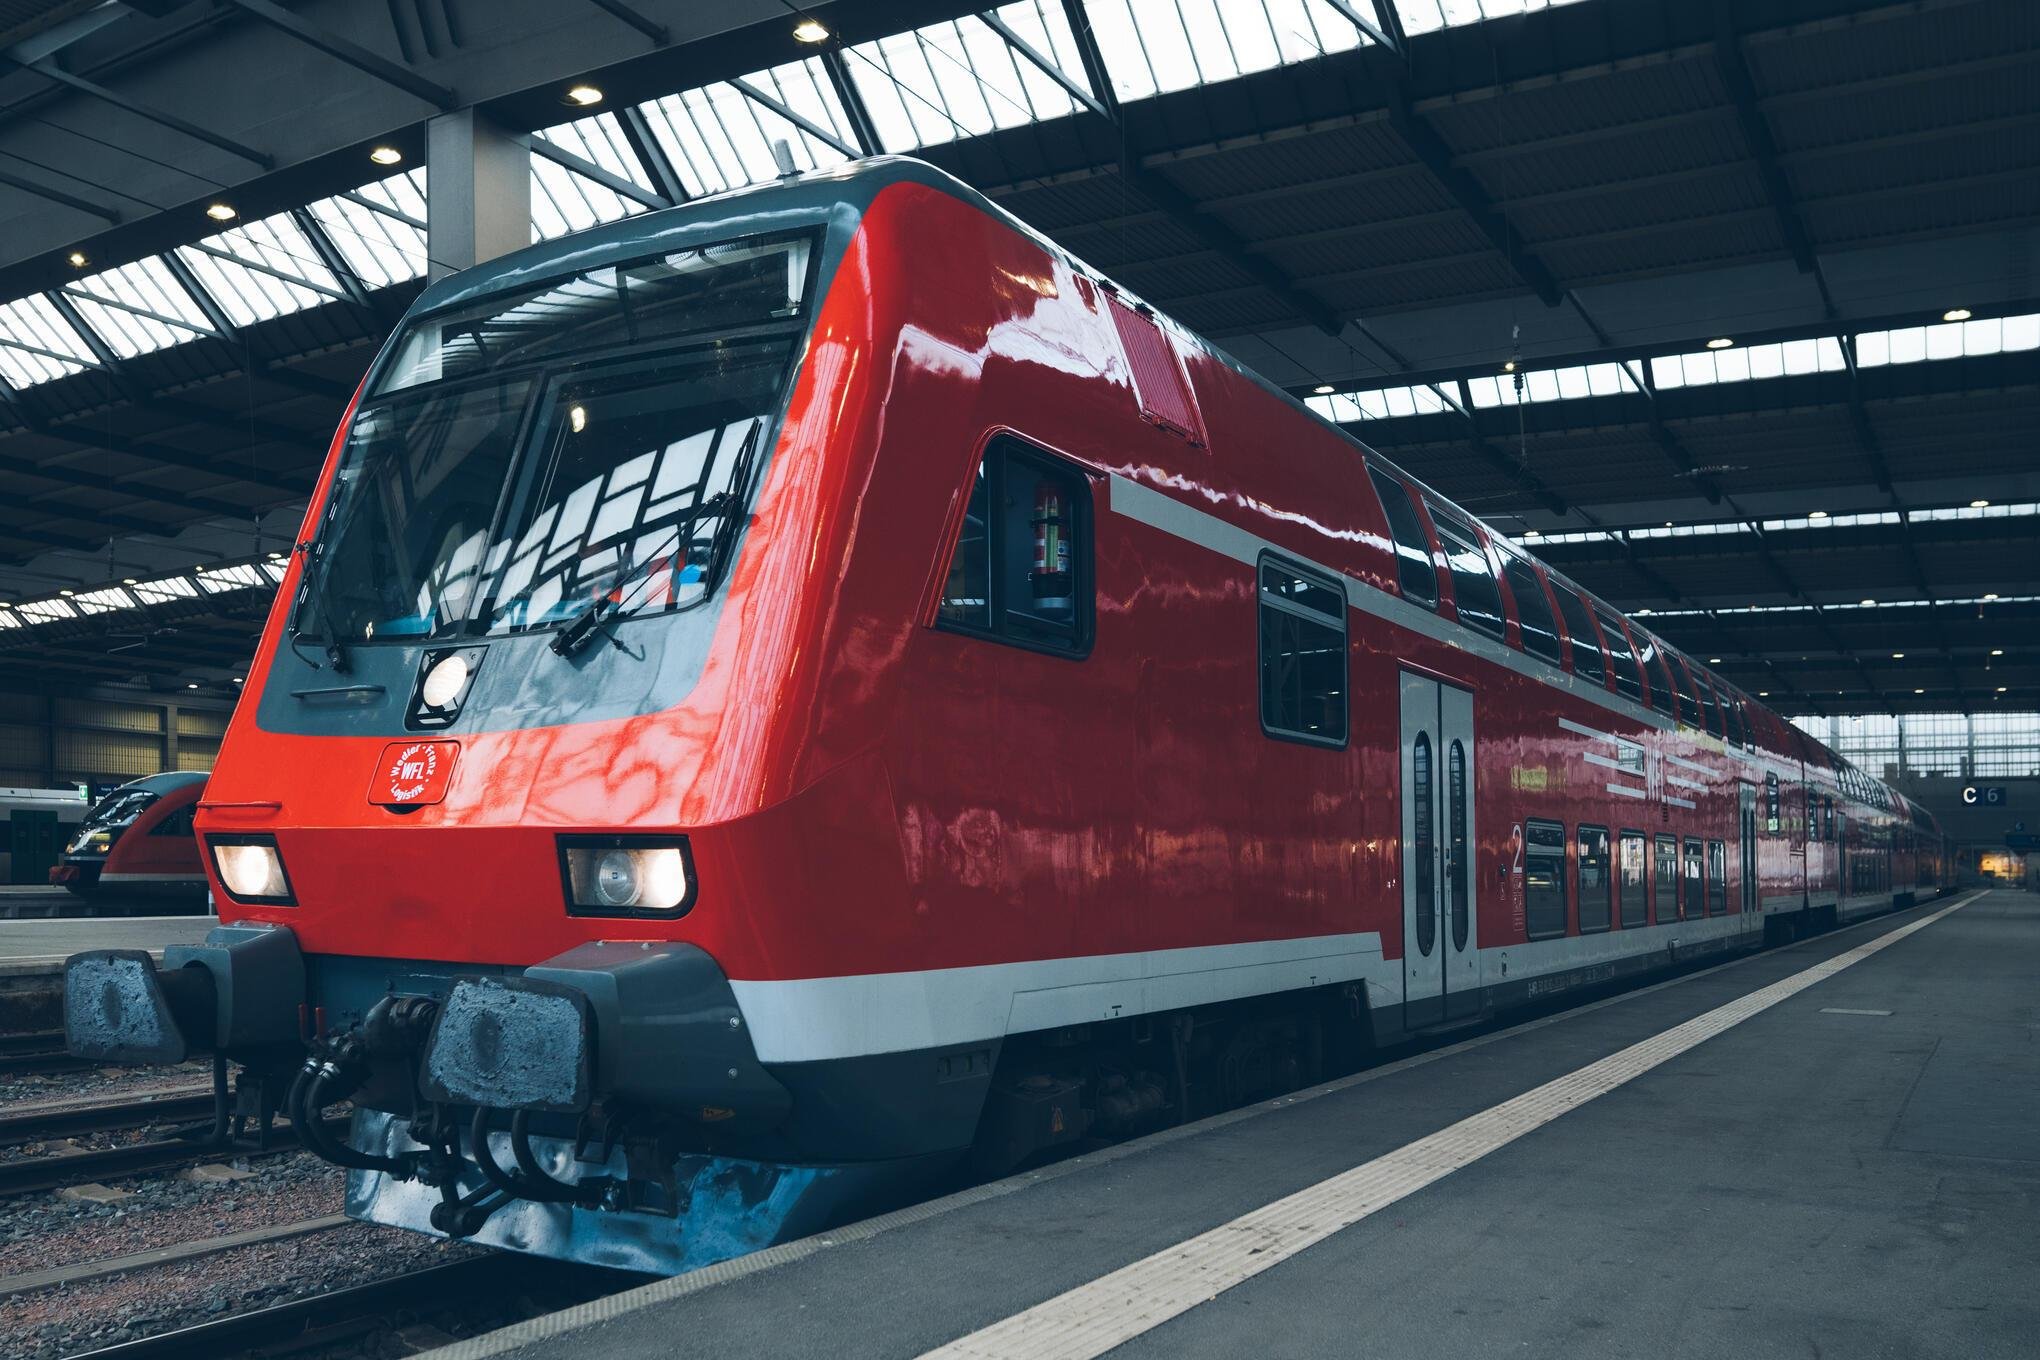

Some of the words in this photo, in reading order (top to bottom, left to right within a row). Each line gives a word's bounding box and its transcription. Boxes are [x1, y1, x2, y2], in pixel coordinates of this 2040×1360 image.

[424, 744, 436, 775] Franz
[400, 762, 425, 780] WFL
[390, 783, 425, 801] Logistik
[1963, 787, 1977, 804] C
[1987, 788, 1998, 802] 6
[1512, 824, 1523, 873] 2
